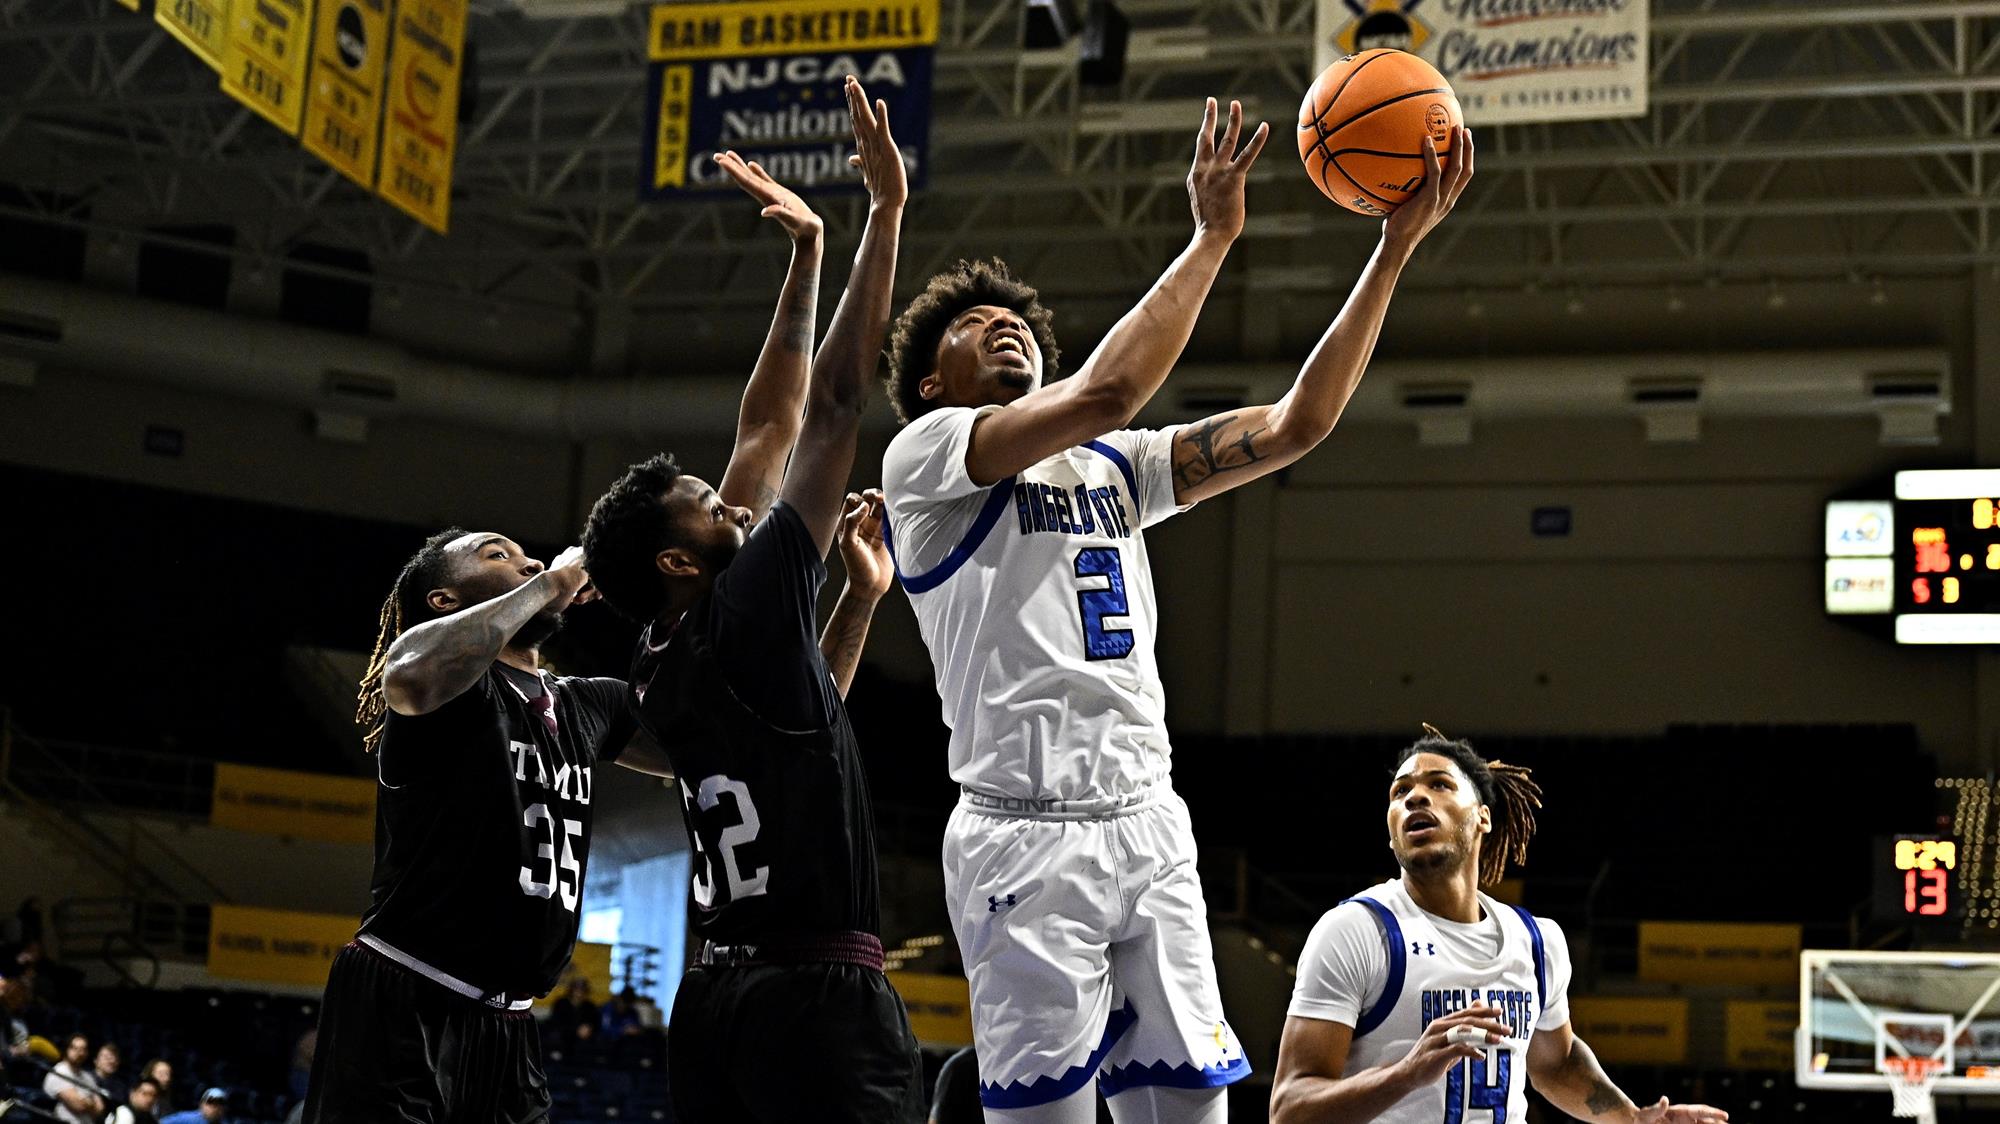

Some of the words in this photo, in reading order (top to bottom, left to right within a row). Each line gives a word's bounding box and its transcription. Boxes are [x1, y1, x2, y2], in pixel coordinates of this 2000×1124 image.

[660, 19, 722, 49] RAM
[740, 7, 923, 45] BASKETBALL
[1436, 26, 1637, 76] Champions
[706, 52, 904, 97] NJCAA
[1073, 546, 1135, 661] 2
[518, 802, 583, 914] 35
[1904, 868, 1947, 916] 13
[1443, 1048, 1512, 1124] 14
